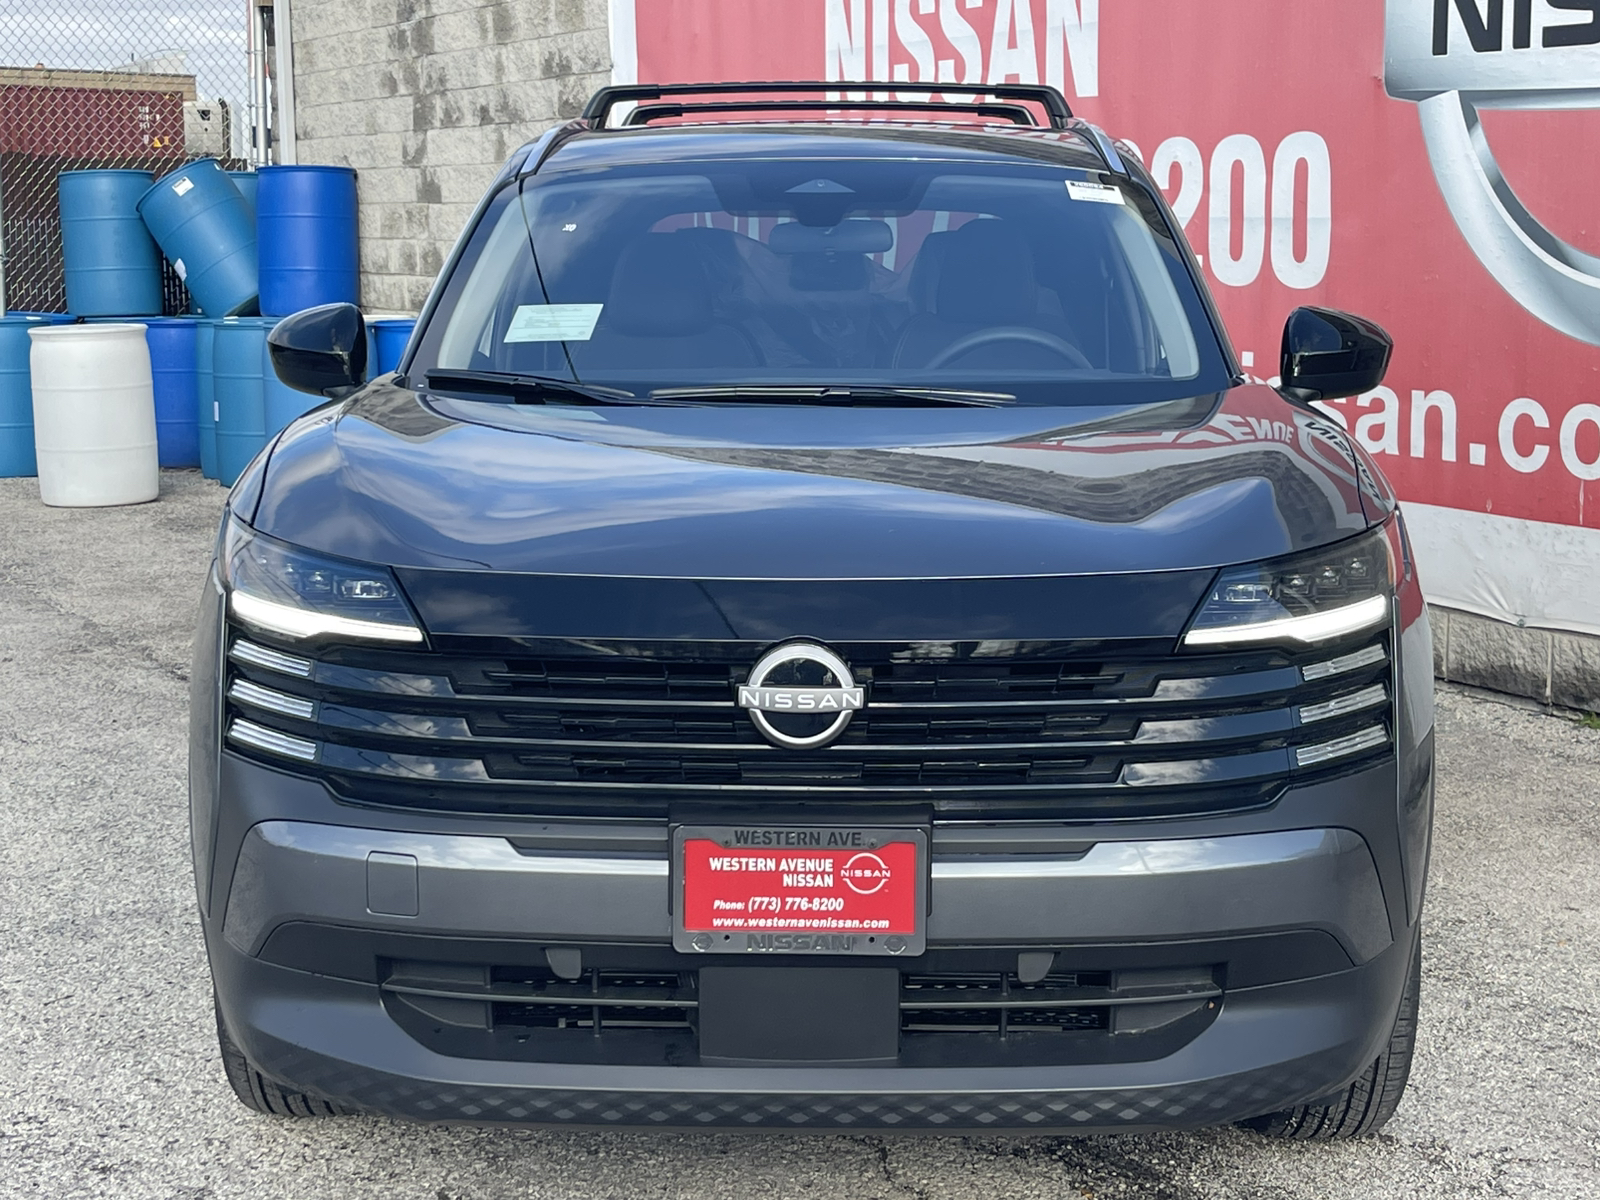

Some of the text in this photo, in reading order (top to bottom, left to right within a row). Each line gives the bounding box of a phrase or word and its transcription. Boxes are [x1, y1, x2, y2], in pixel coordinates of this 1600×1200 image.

[825, 0, 1099, 113] NISSAN
[741, 690, 861, 709] NISSAN
[734, 830, 821, 847] WESTERN
[709, 857, 833, 873] WESTERN AVENUE
[782, 874, 833, 887] NISSAN
[840, 869, 891, 878] NISSAN
[713, 897, 844, 913] Phone: (773) 776-8200
[712, 917, 890, 929] www.westernavenissan.com
[746, 934, 853, 952] NISSAN
